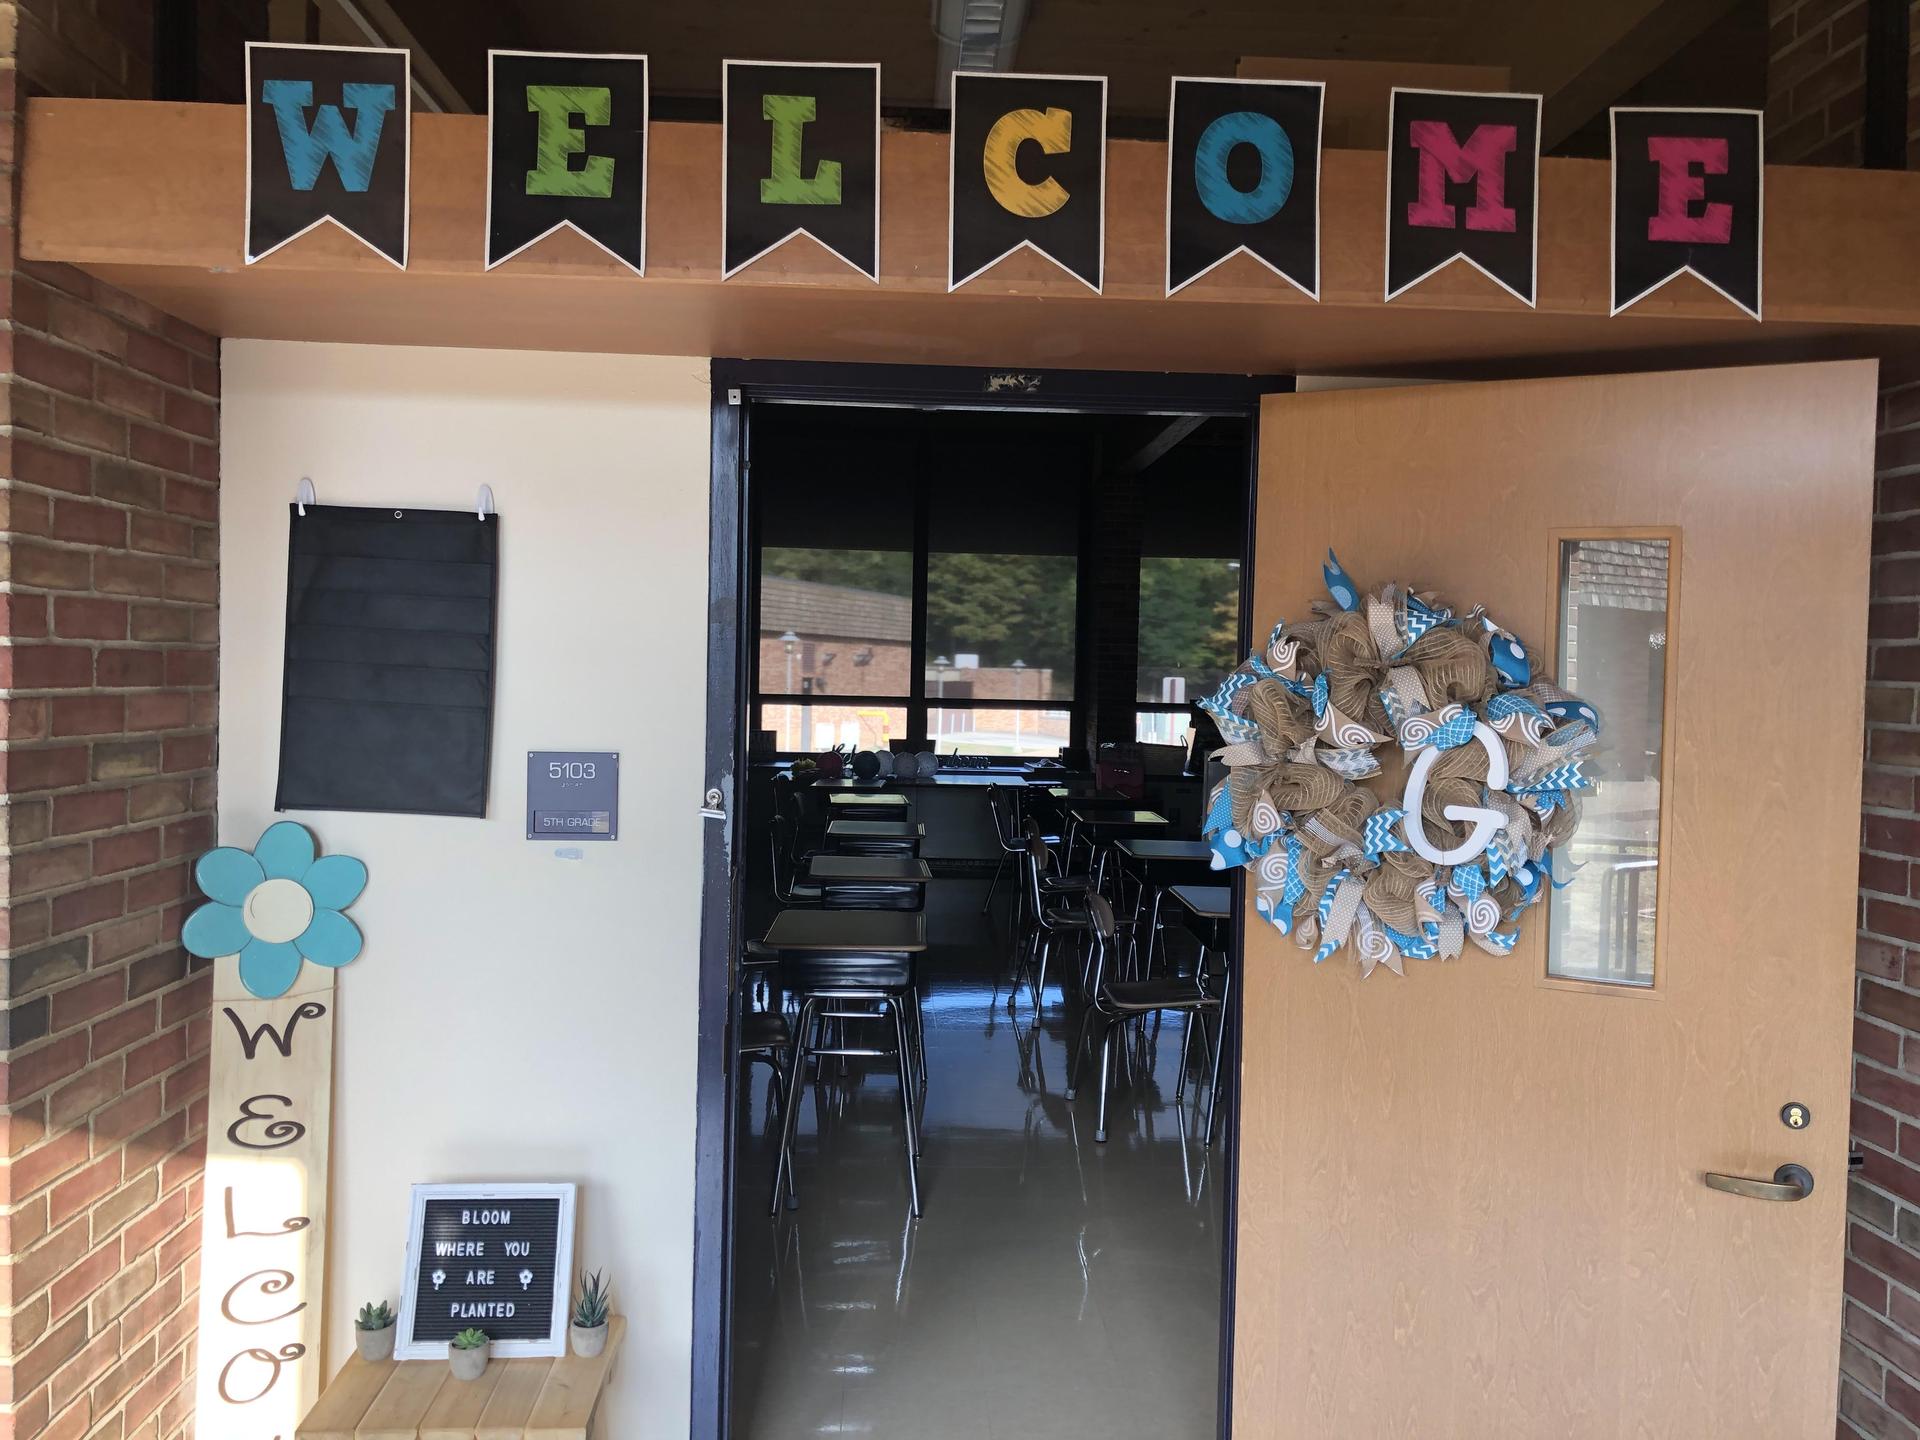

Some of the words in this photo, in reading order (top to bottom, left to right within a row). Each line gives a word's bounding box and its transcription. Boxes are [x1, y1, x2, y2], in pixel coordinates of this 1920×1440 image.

[262, 79, 1733, 244] WELCOME
[549, 762, 596, 779] 5103
[1403, 721, 1508, 866] G
[543, 817, 564, 827] 5TH
[567, 817, 601, 827] GRADE
[219, 1002, 326, 1440] WELCO
[461, 1209, 511, 1225] BLOOM
[435, 1241, 485, 1257] WHERE
[504, 1241, 530, 1257] YOU
[465, 1269, 496, 1285] ARE
[450, 1302, 516, 1318] PLANTED
